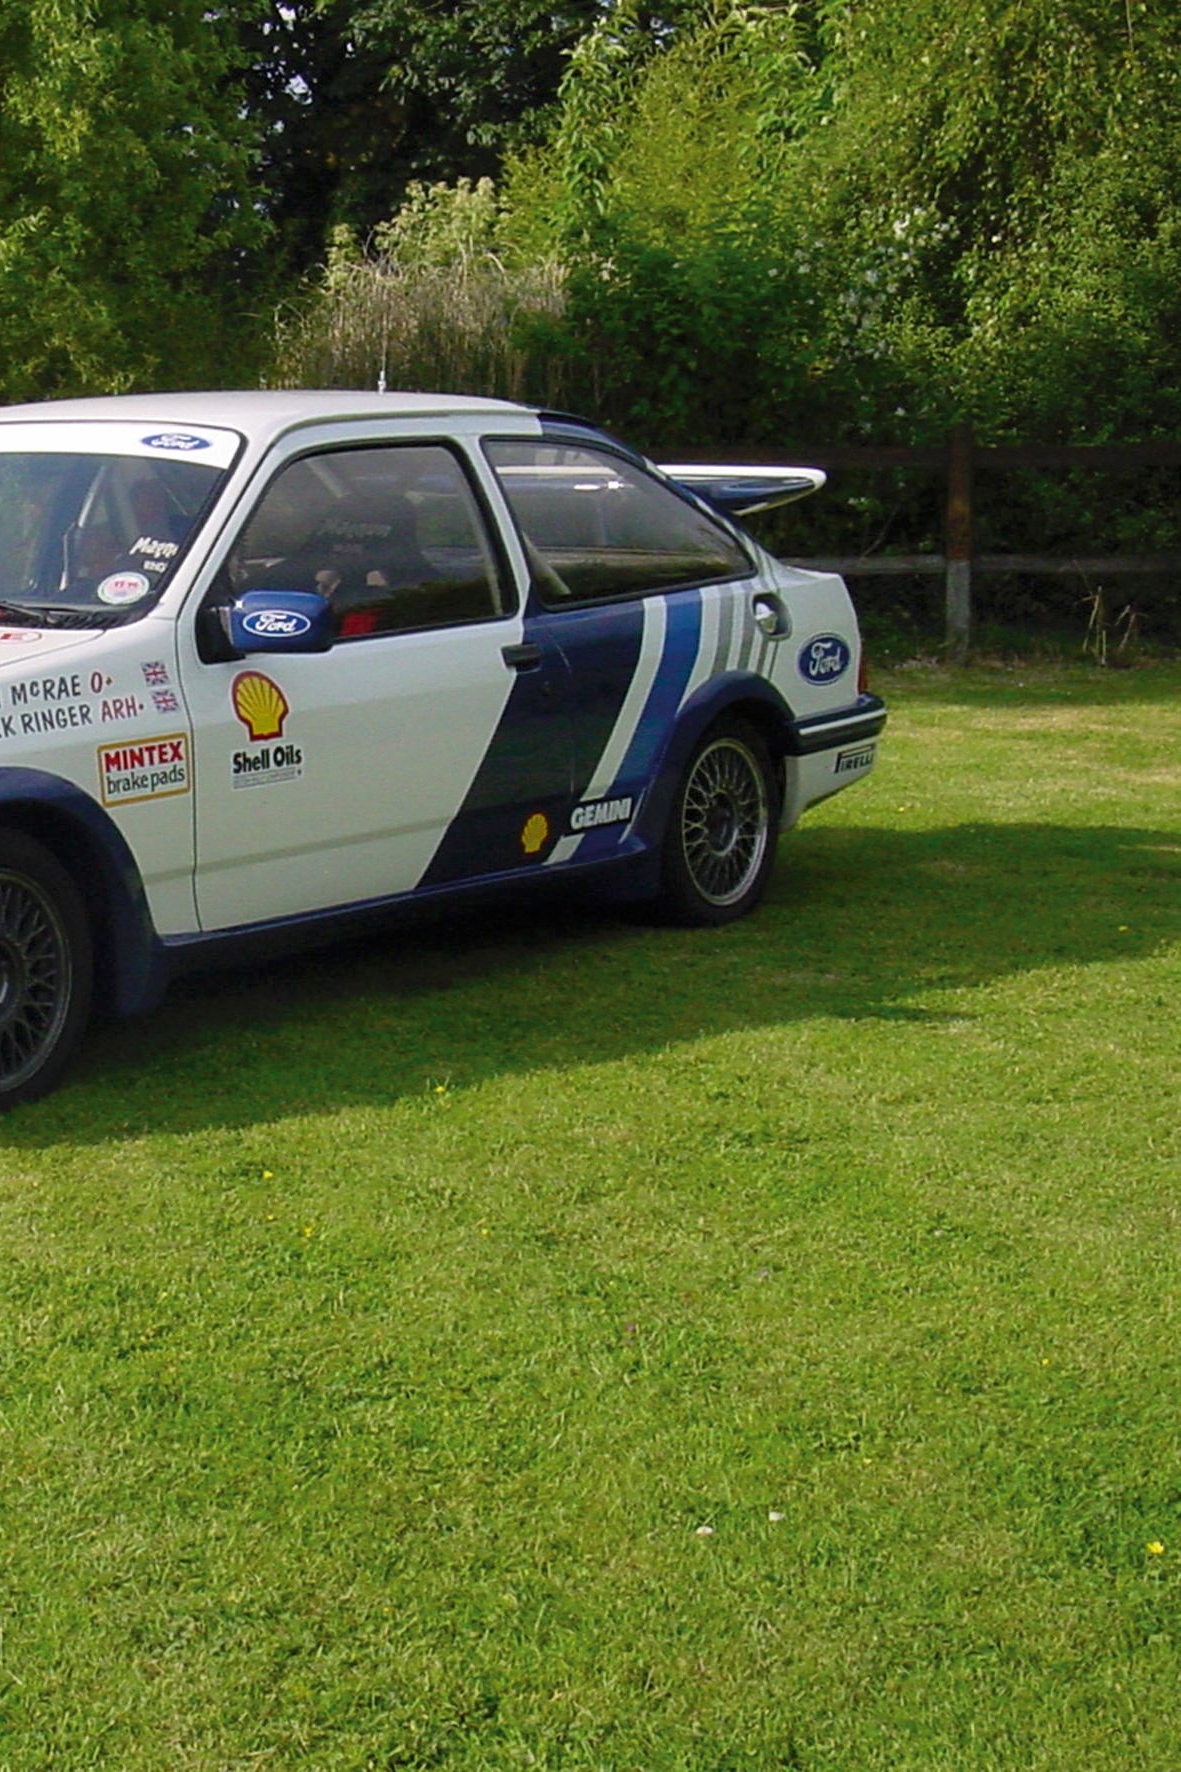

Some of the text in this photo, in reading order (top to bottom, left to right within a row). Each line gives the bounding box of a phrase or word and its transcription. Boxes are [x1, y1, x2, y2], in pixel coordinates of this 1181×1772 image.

[151, 435, 200, 449] Ford
[255, 613, 297, 632] Ford
[809, 641, 842, 676] Ford
[21, 704, 92, 734] RINGER
[104, 740, 184, 772] MINTEX
[233, 744, 302, 774] Shell Oils
[834, 742, 876, 773] PIRELLI
[107, 765, 185, 795] brake pads
[571, 797, 632, 830] GEMINI
